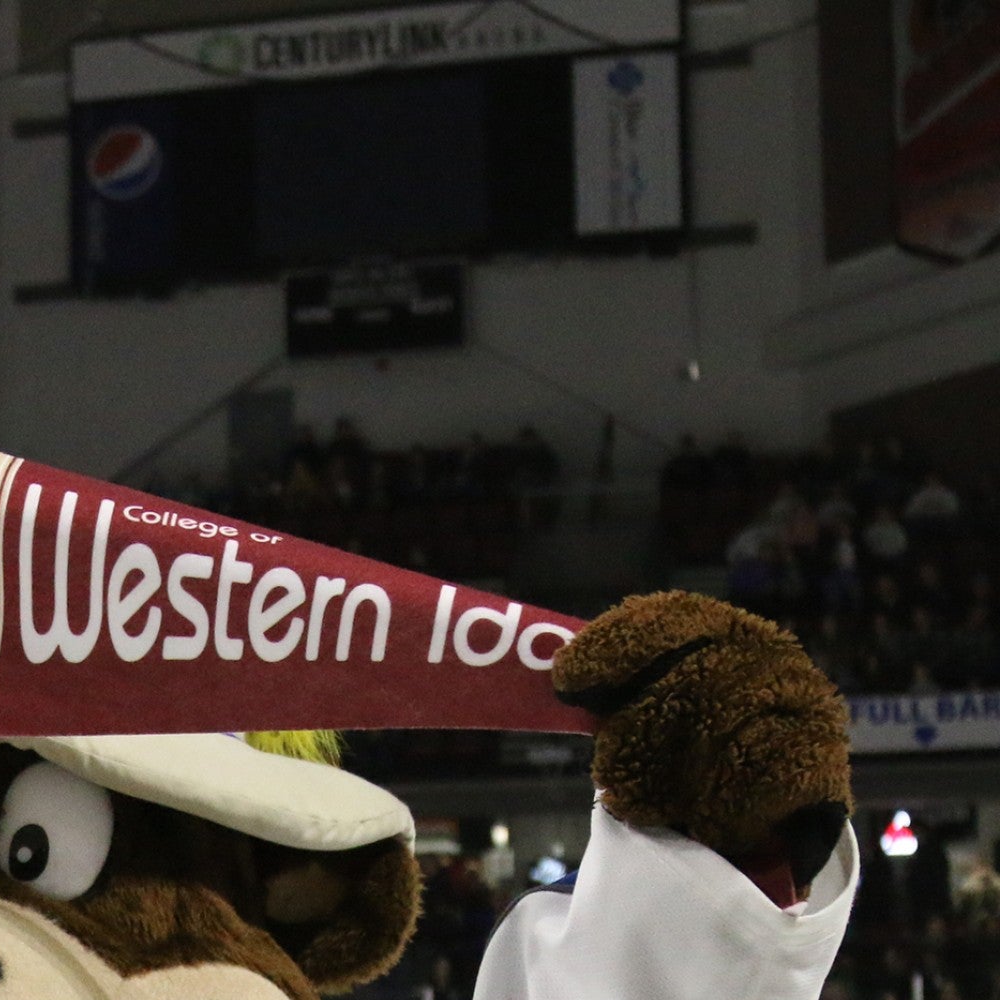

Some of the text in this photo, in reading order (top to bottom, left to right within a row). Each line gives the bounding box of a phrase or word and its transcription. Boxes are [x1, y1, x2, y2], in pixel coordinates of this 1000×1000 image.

[123, 505, 239, 538] College
[19, 483, 391, 664] Western
[847, 696, 926, 726] FULL
